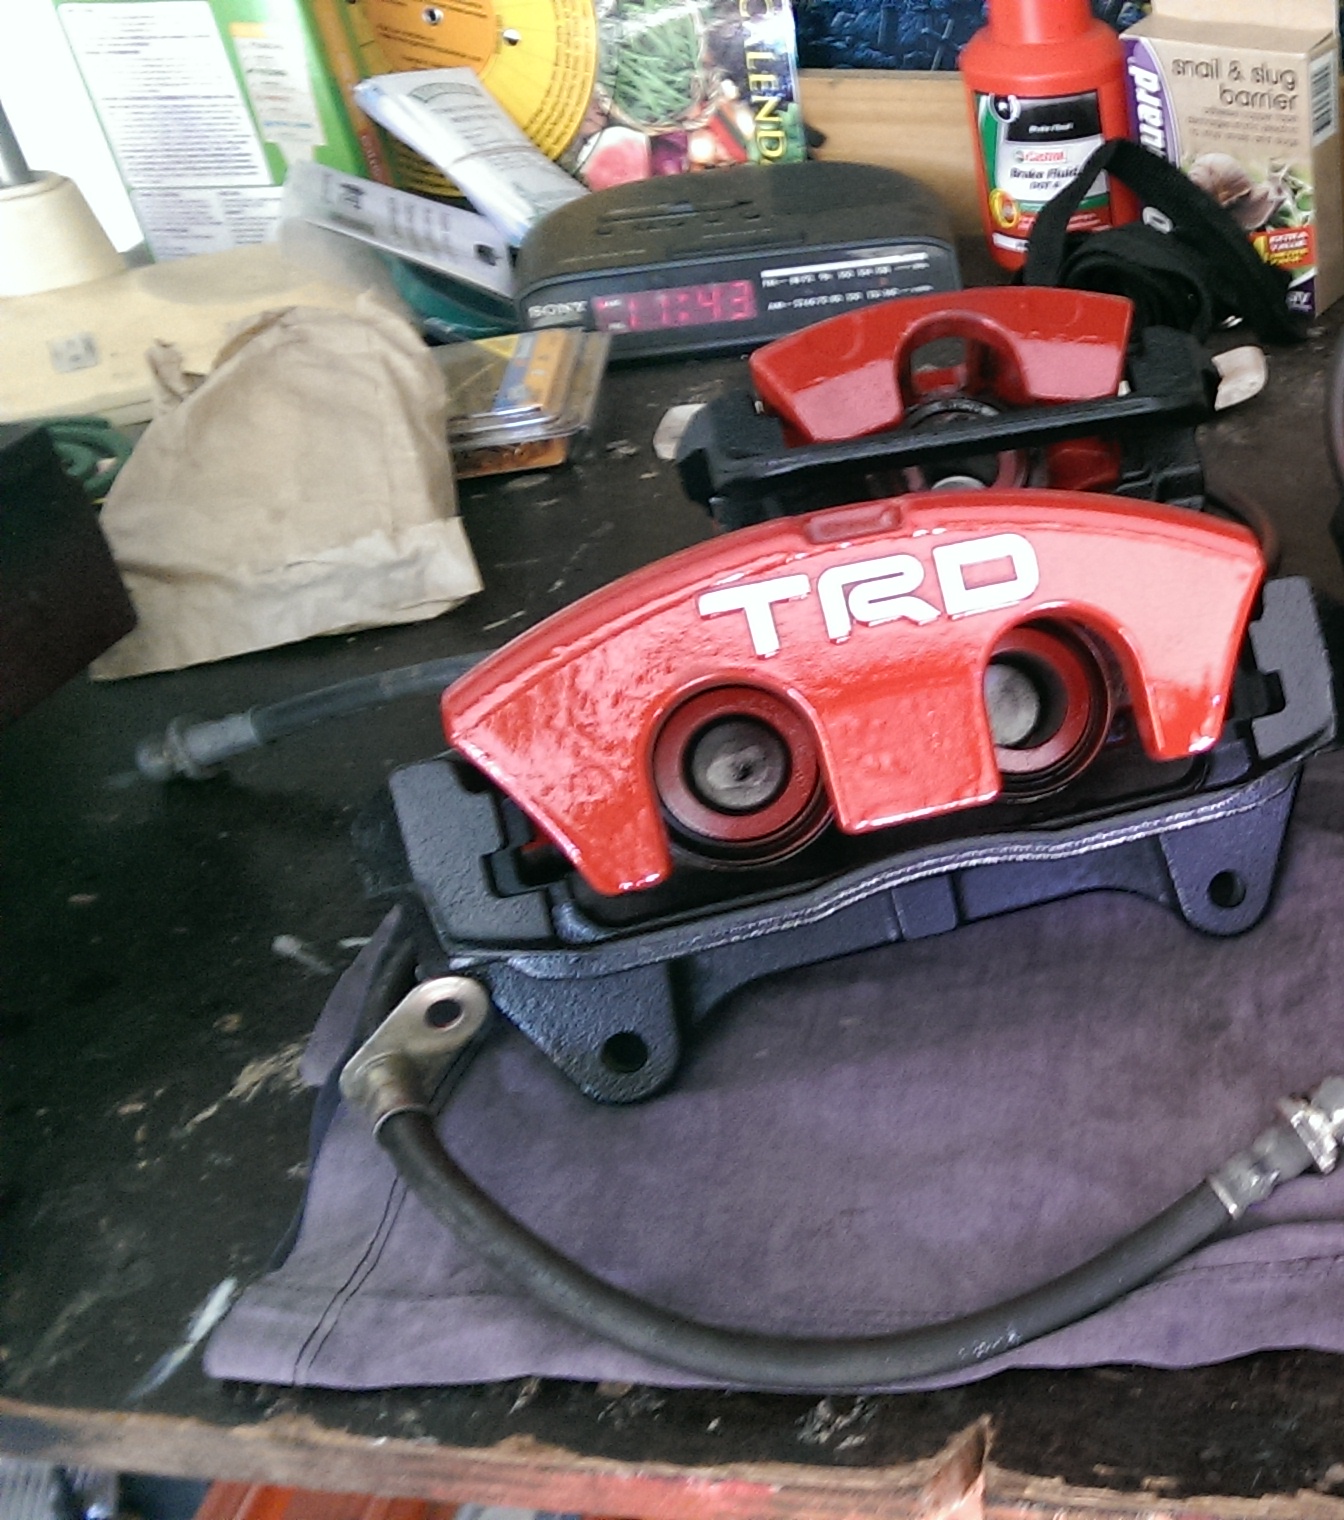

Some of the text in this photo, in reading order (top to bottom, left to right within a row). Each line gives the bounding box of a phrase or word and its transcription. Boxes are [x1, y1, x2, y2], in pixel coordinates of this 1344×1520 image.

[1171, 57, 1296, 92] snail & slug
[1128, 62, 1167, 158] uard
[1219, 83, 1299, 110] barrier
[528, 300, 589, 318] SONY
[628, 281, 752, 328] 11:43
[697, 532, 1039, 659] TRD
